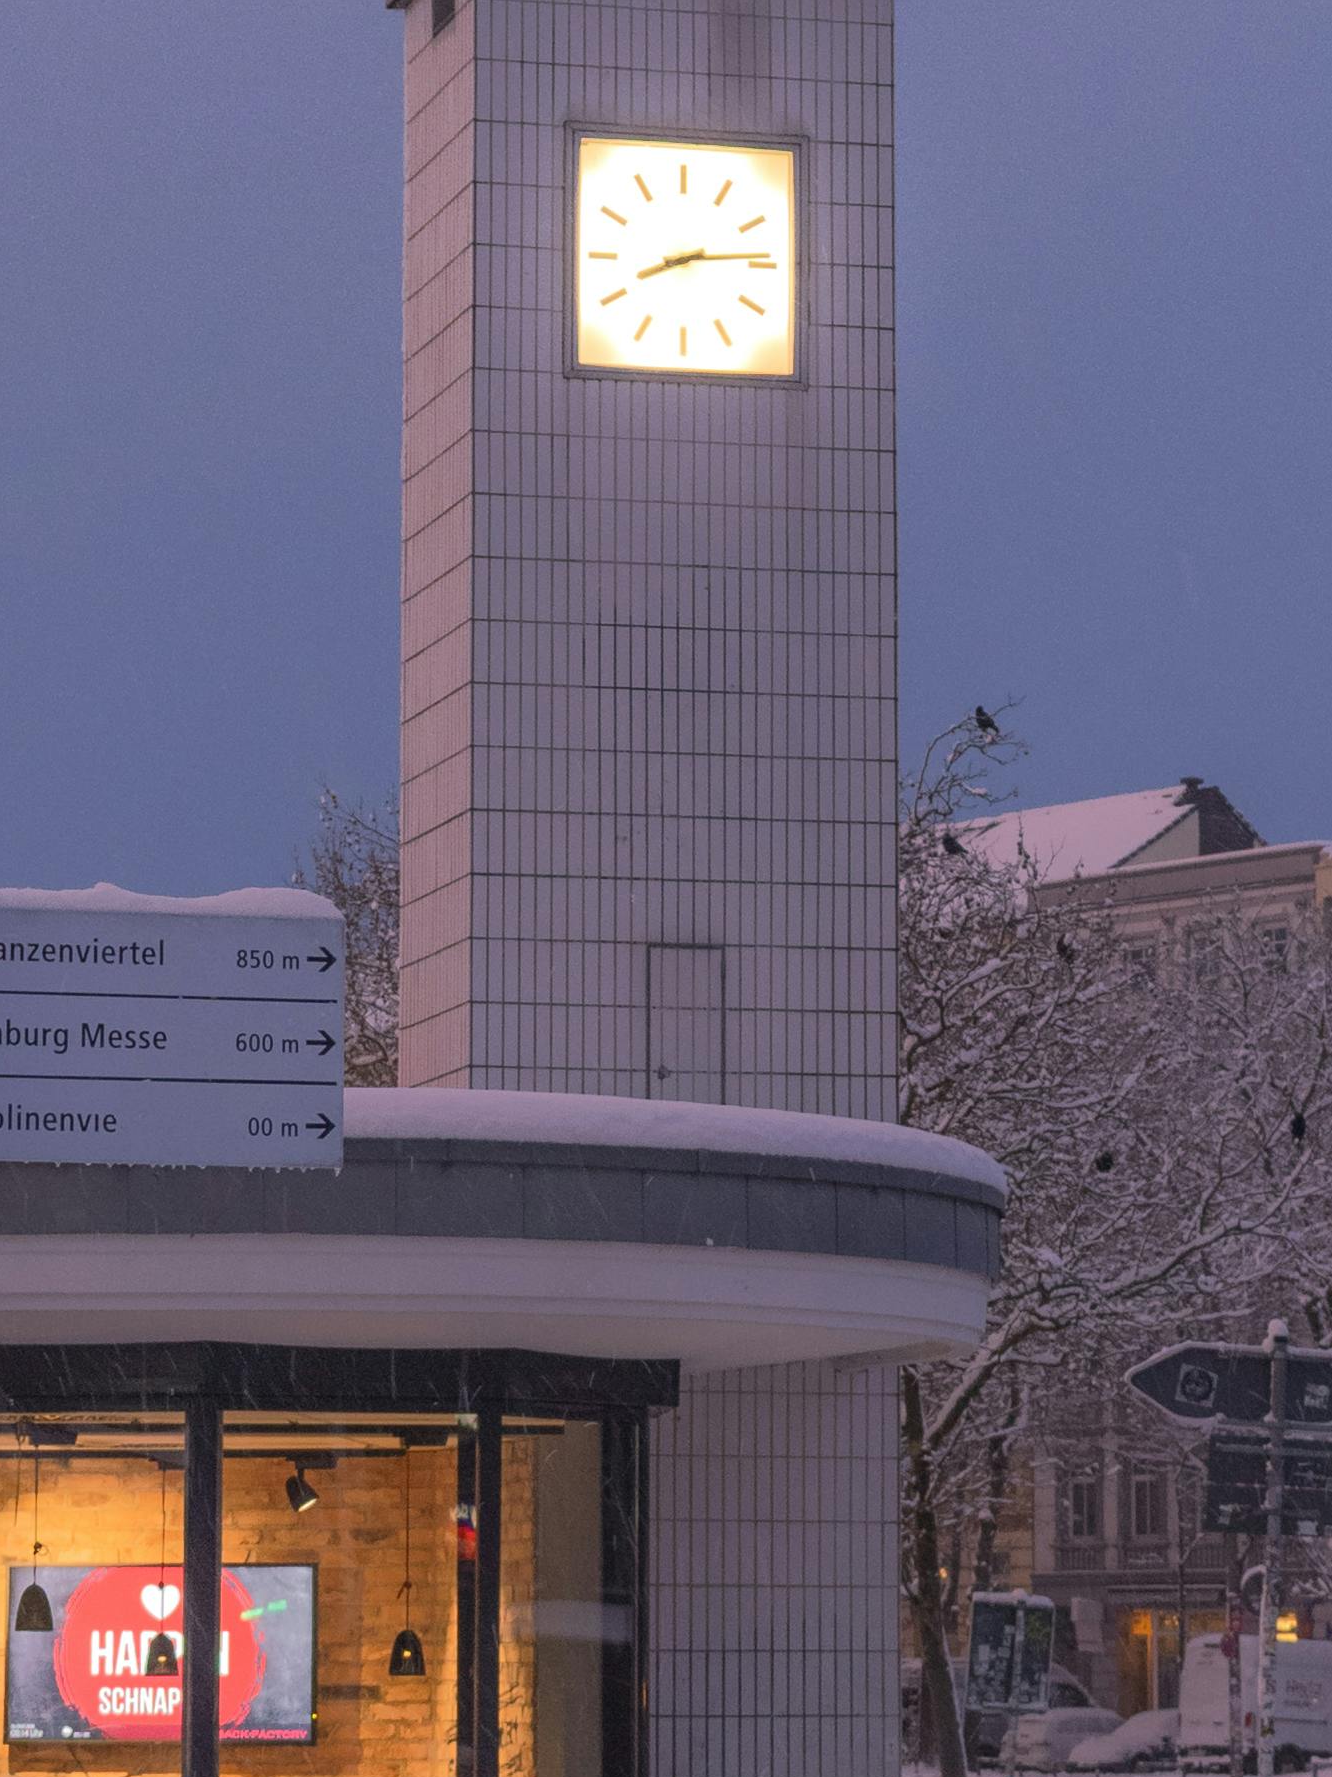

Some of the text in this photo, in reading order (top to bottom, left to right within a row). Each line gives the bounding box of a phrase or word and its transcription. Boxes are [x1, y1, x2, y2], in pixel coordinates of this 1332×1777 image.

[236, 949, 274, 970] 850
[281, 955, 300, 970] m
[81, 1023, 168, 1050] Messe
[235, 1033, 274, 1054] 600
[281, 1039, 300, 1054] m
[280, 1123, 299, 1137] m
